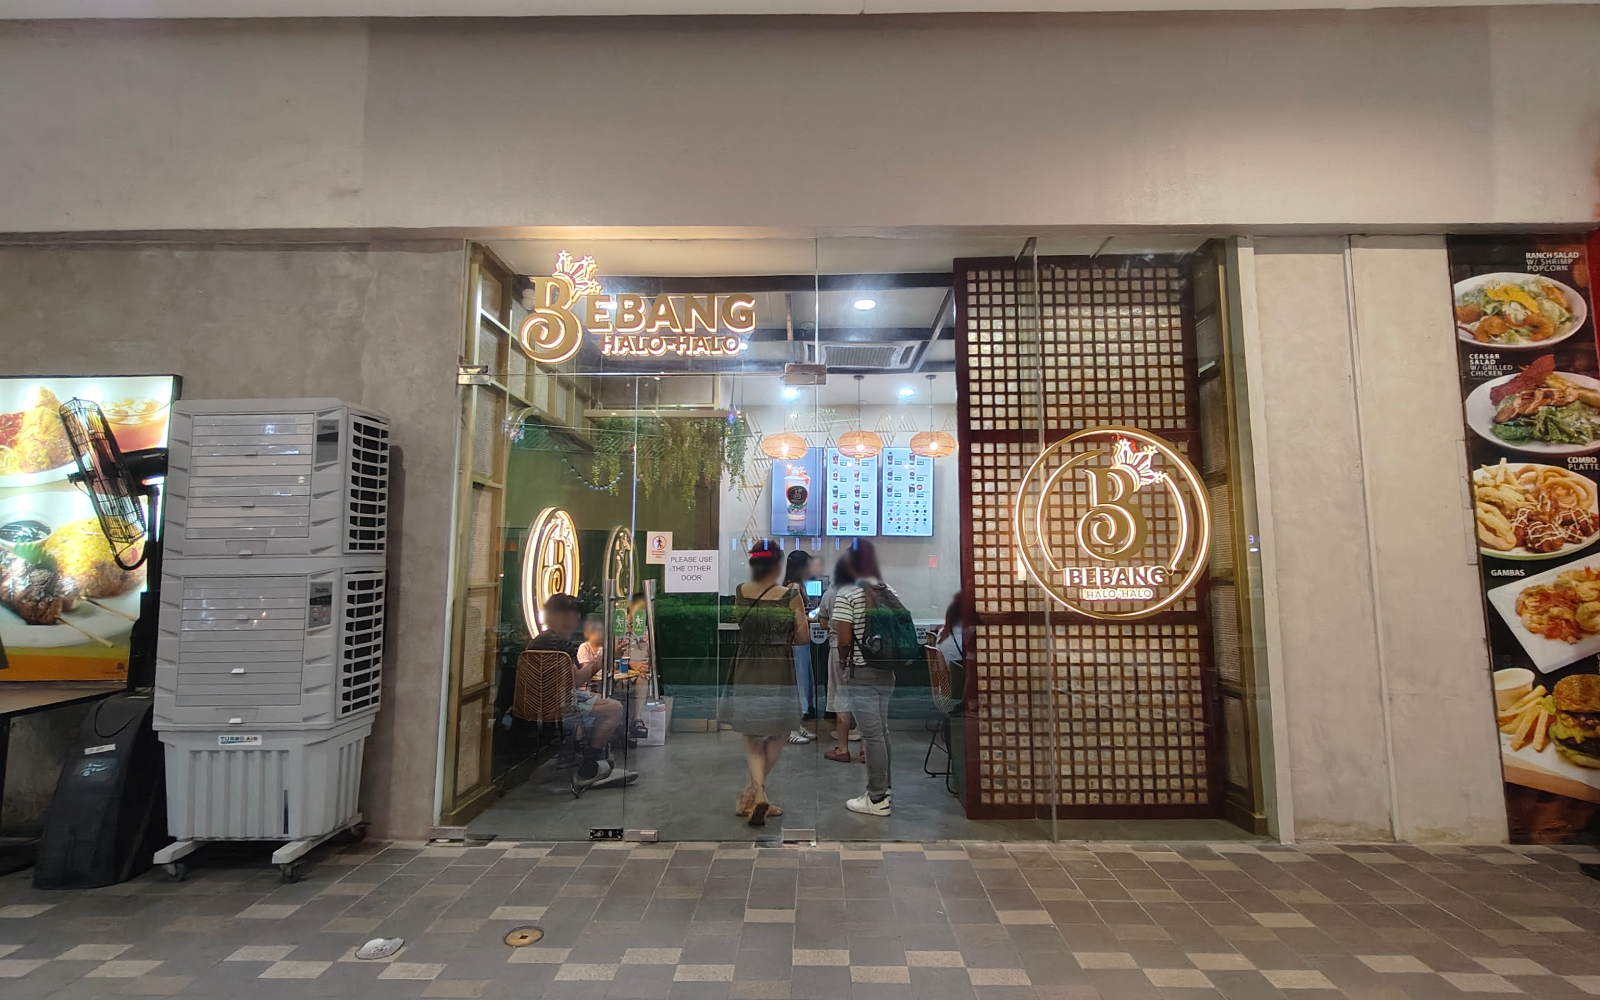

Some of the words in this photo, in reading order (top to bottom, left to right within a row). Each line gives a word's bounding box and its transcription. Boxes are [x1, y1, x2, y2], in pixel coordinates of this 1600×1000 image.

[518, 276, 757, 364] BEBANG
[602, 334, 741, 356] HALO-HALO
[1567, 456, 1598, 464] COMBO
[1064, 567, 1166, 587] BEBANG
[1490, 568, 1526, 577] GAMBAS
[1083, 588, 1154, 600] HALO-HALO
